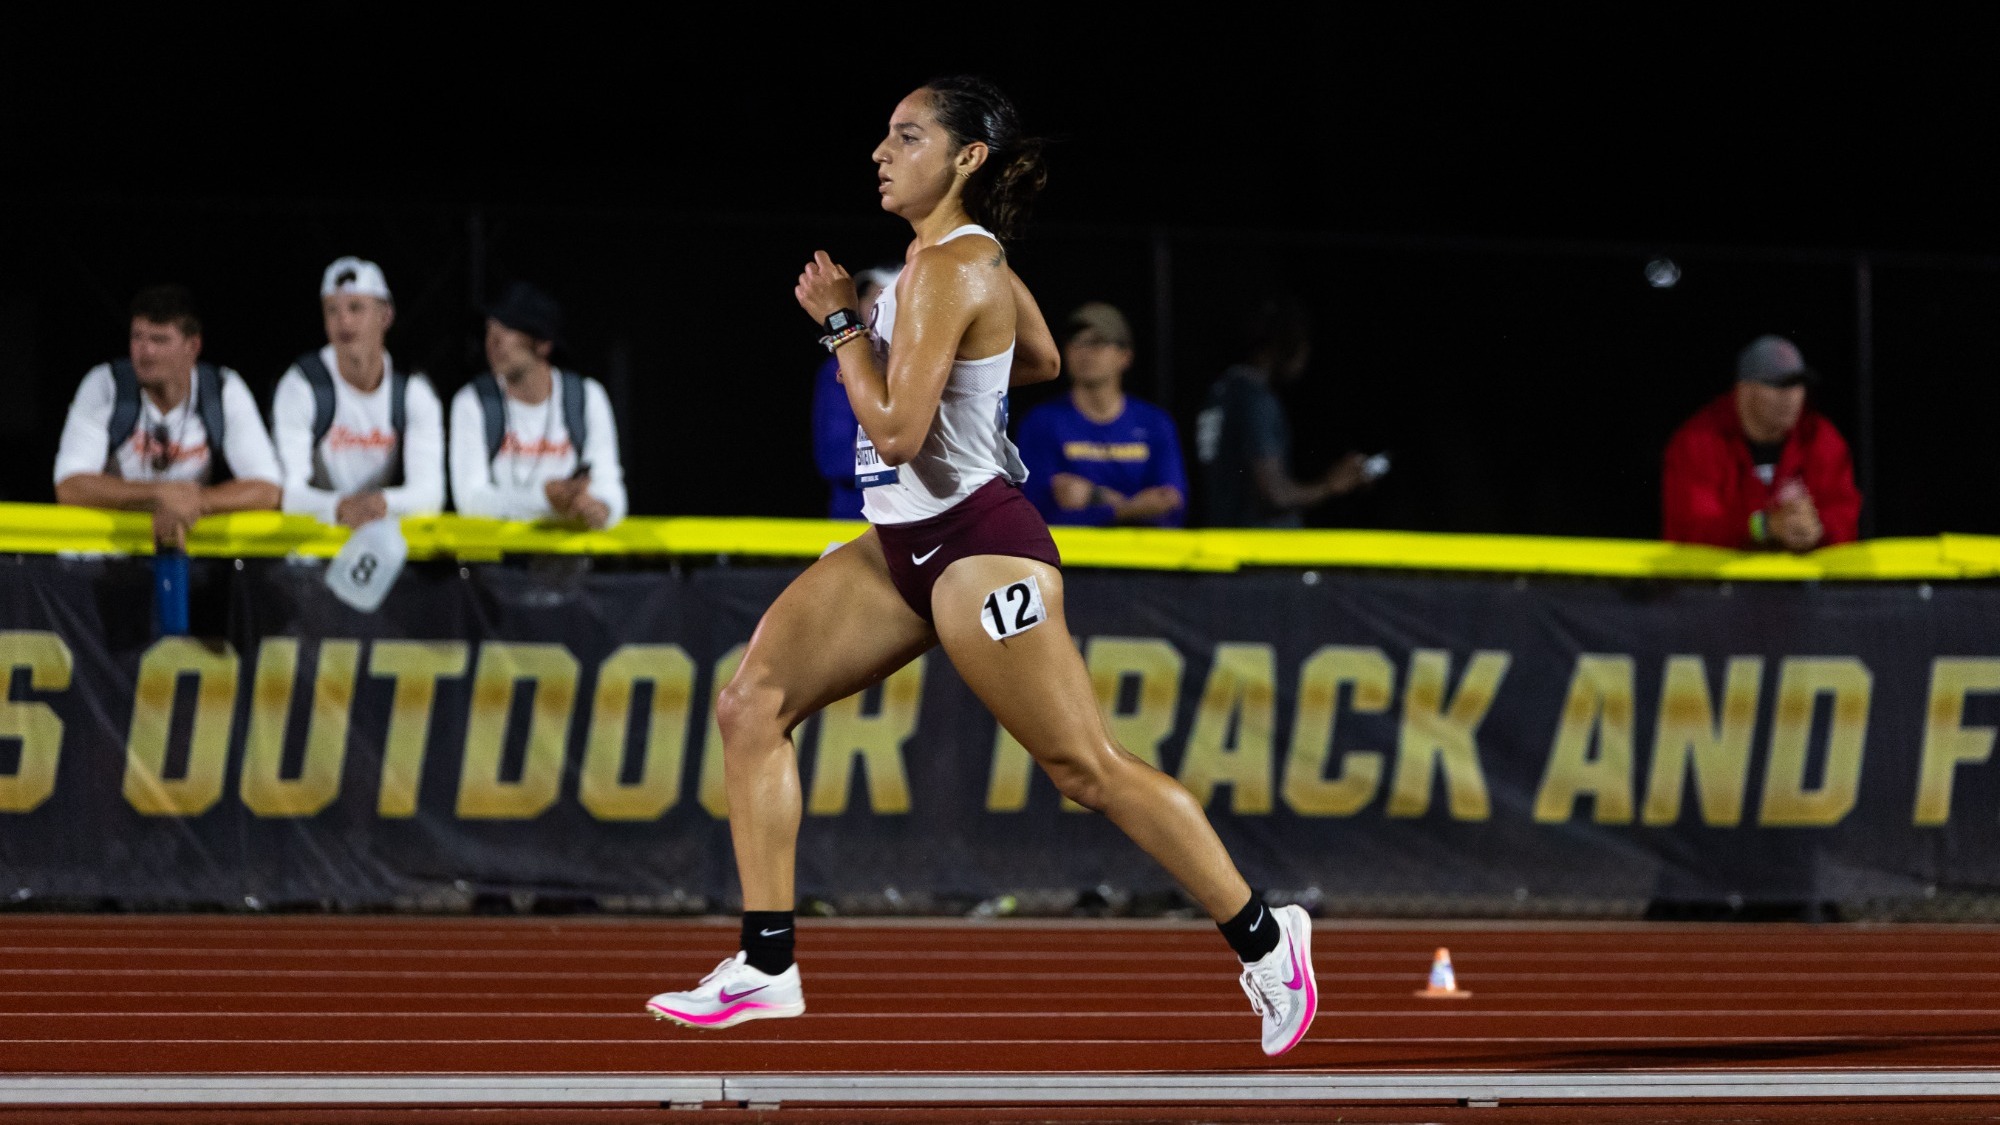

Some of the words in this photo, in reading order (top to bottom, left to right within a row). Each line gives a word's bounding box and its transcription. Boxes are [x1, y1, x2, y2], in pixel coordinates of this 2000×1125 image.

[350, 553, 378, 587] 8
[984, 582, 1039, 635] 12
[1532, 652, 1874, 827] AND
